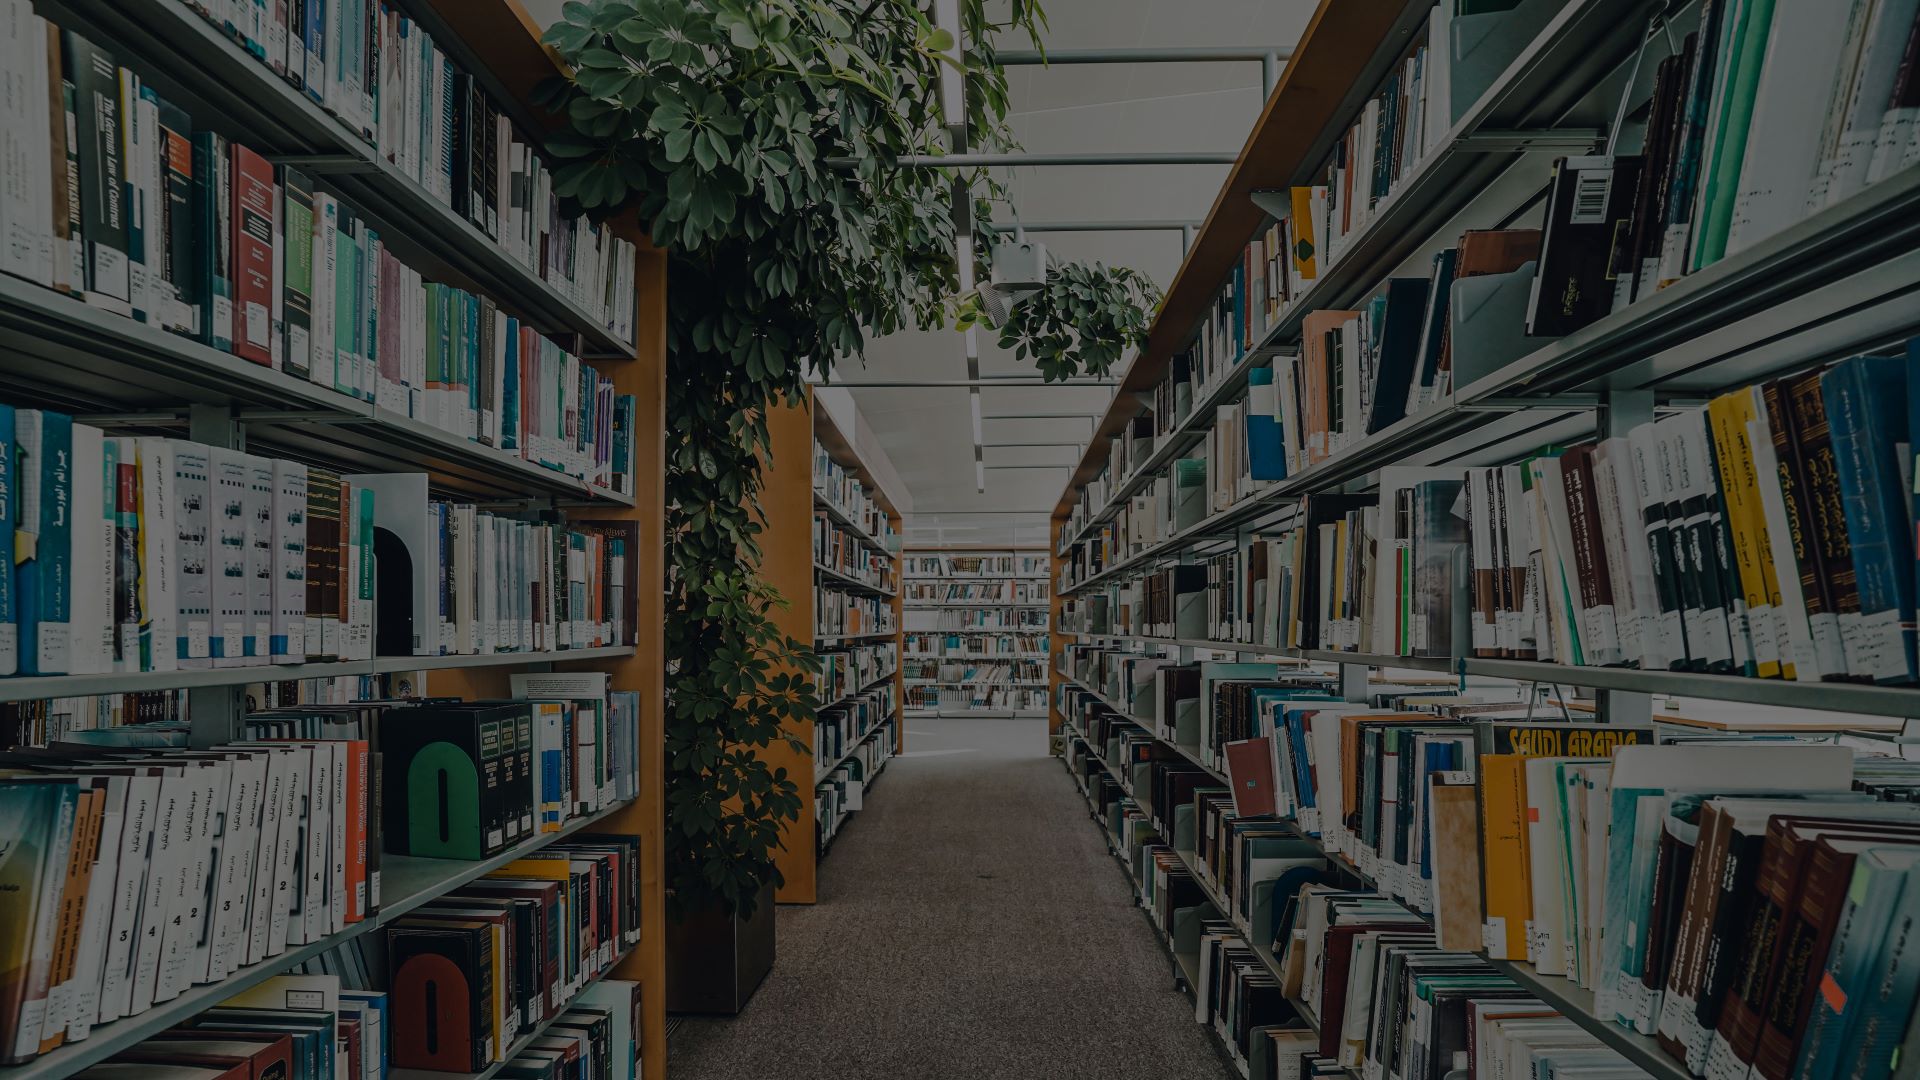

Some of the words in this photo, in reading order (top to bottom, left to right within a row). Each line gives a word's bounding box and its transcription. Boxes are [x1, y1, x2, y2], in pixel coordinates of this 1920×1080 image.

[104, 97, 116, 116] The
[105, 117, 117, 155] German
[107, 156, 118, 176] Law
[108, 176, 120, 191] of
[109, 189, 121, 230] Contract
[326, 256, 335, 272] Law
[52, 485, 67, 527] البورصة
[1509, 727, 1562, 757] SAUDI
[313, 872, 319, 881] 4
[279, 881, 287, 891] 2
[190, 908, 198, 918] 2
[223, 900, 231, 911] 3
[173, 915, 181, 926] 4
[120, 930, 128, 942] 3
[148, 926, 155, 937] 4
